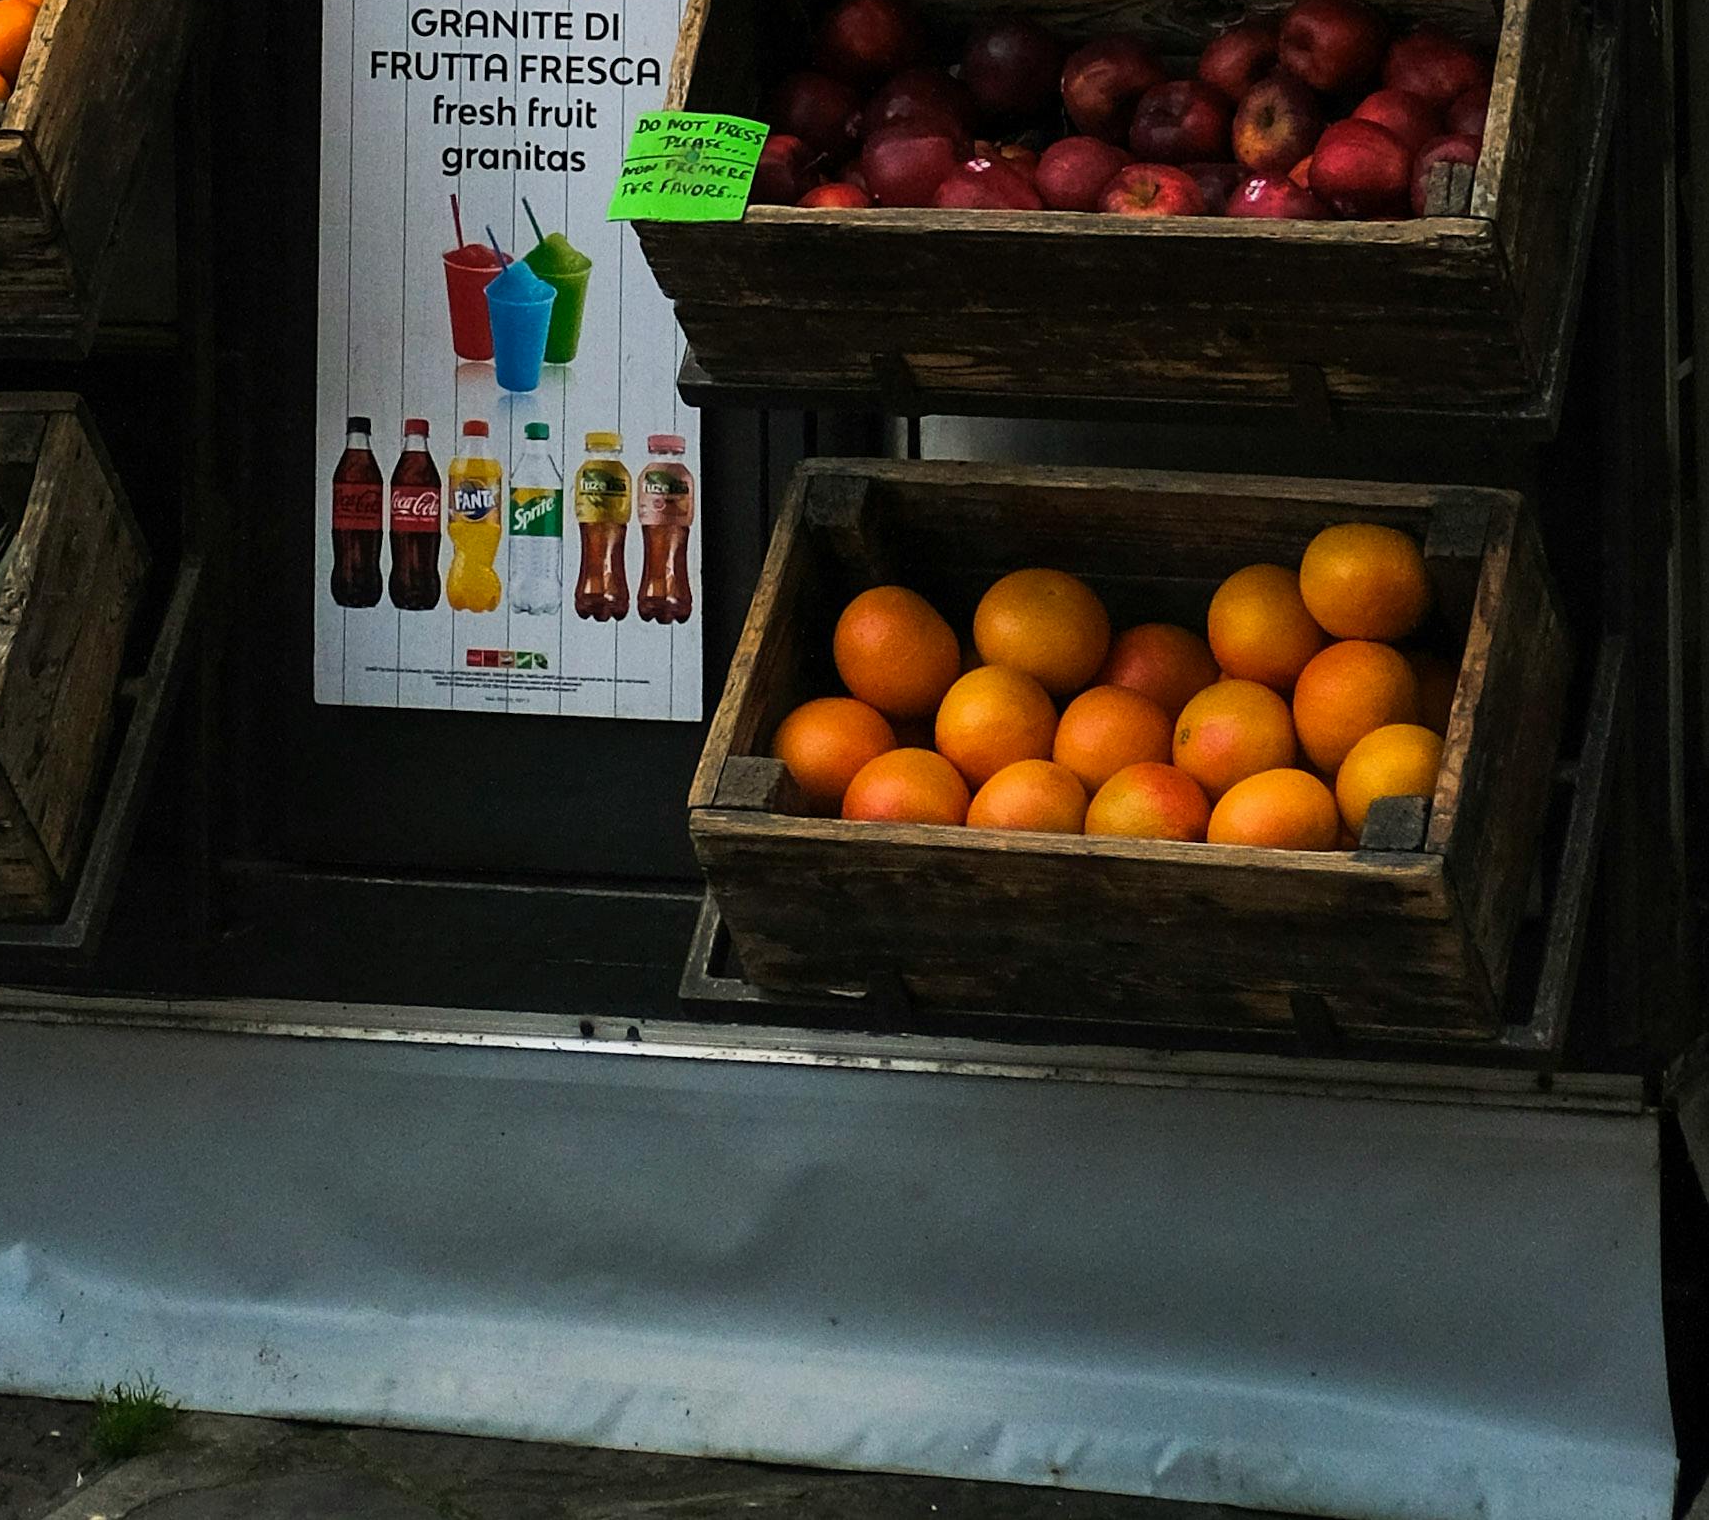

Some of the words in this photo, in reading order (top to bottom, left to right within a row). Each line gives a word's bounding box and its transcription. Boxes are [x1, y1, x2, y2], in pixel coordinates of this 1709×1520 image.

[411, 7, 574, 40] GRANITE
[585, 13, 621, 42] DI
[370, 51, 509, 84] FRUTTA
[520, 54, 663, 87] FRESCA
[432, 95, 517, 128] fresh
[527, 98, 598, 130] fruit
[635, 119, 661, 134] DO
[667, 119, 709, 131] NOT
[715, 121, 767, 145] PRESS
[441, 141, 587, 177] granitas
[622, 163, 658, 178] NON
[622, 181, 653, 197] PER
[513, 497, 555, 531] Sprite
